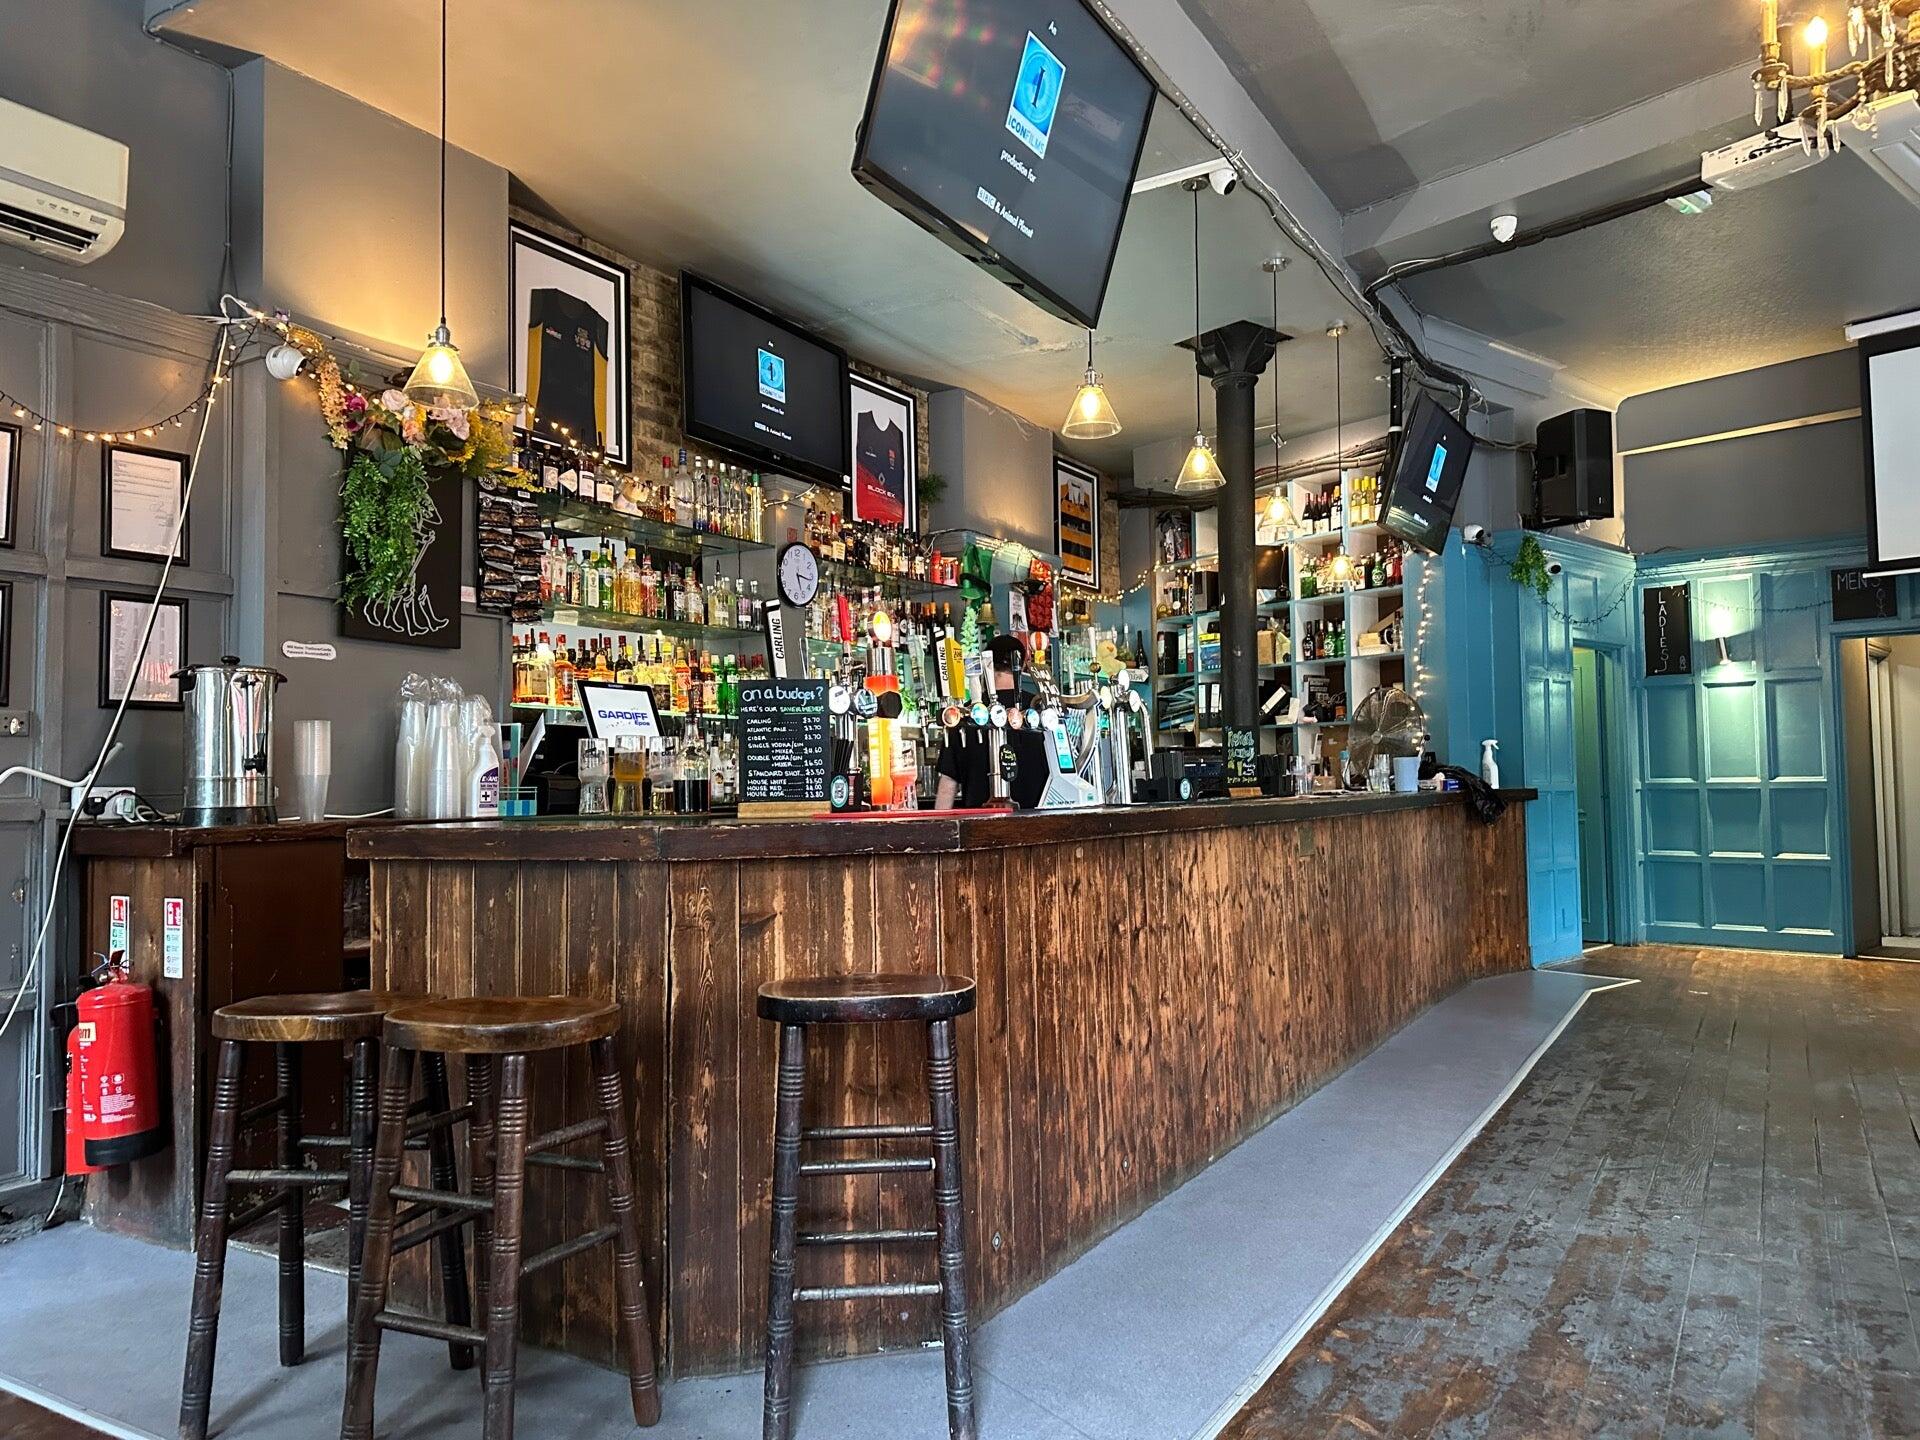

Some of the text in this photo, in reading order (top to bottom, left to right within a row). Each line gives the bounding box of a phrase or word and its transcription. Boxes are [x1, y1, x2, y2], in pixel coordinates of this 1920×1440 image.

[1000, 149, 1037, 183] production for
[994, 201, 1001, 214] &
[1000, 206, 1020, 227] Animal
[1017, 218, 1034, 239] Planet
[868, 484, 887, 496] BLOCK
[795, 549, 800, 557] 12
[1658, 590, 1669, 661] LADIES
[772, 618, 785, 659] CARLING
[939, 647, 949, 681] CARLING
[742, 689, 761, 702] on
[764, 688, 774, 699] a
[598, 709, 648, 720] GARDIFF
[747, 769, 783, 777] STANDARD
